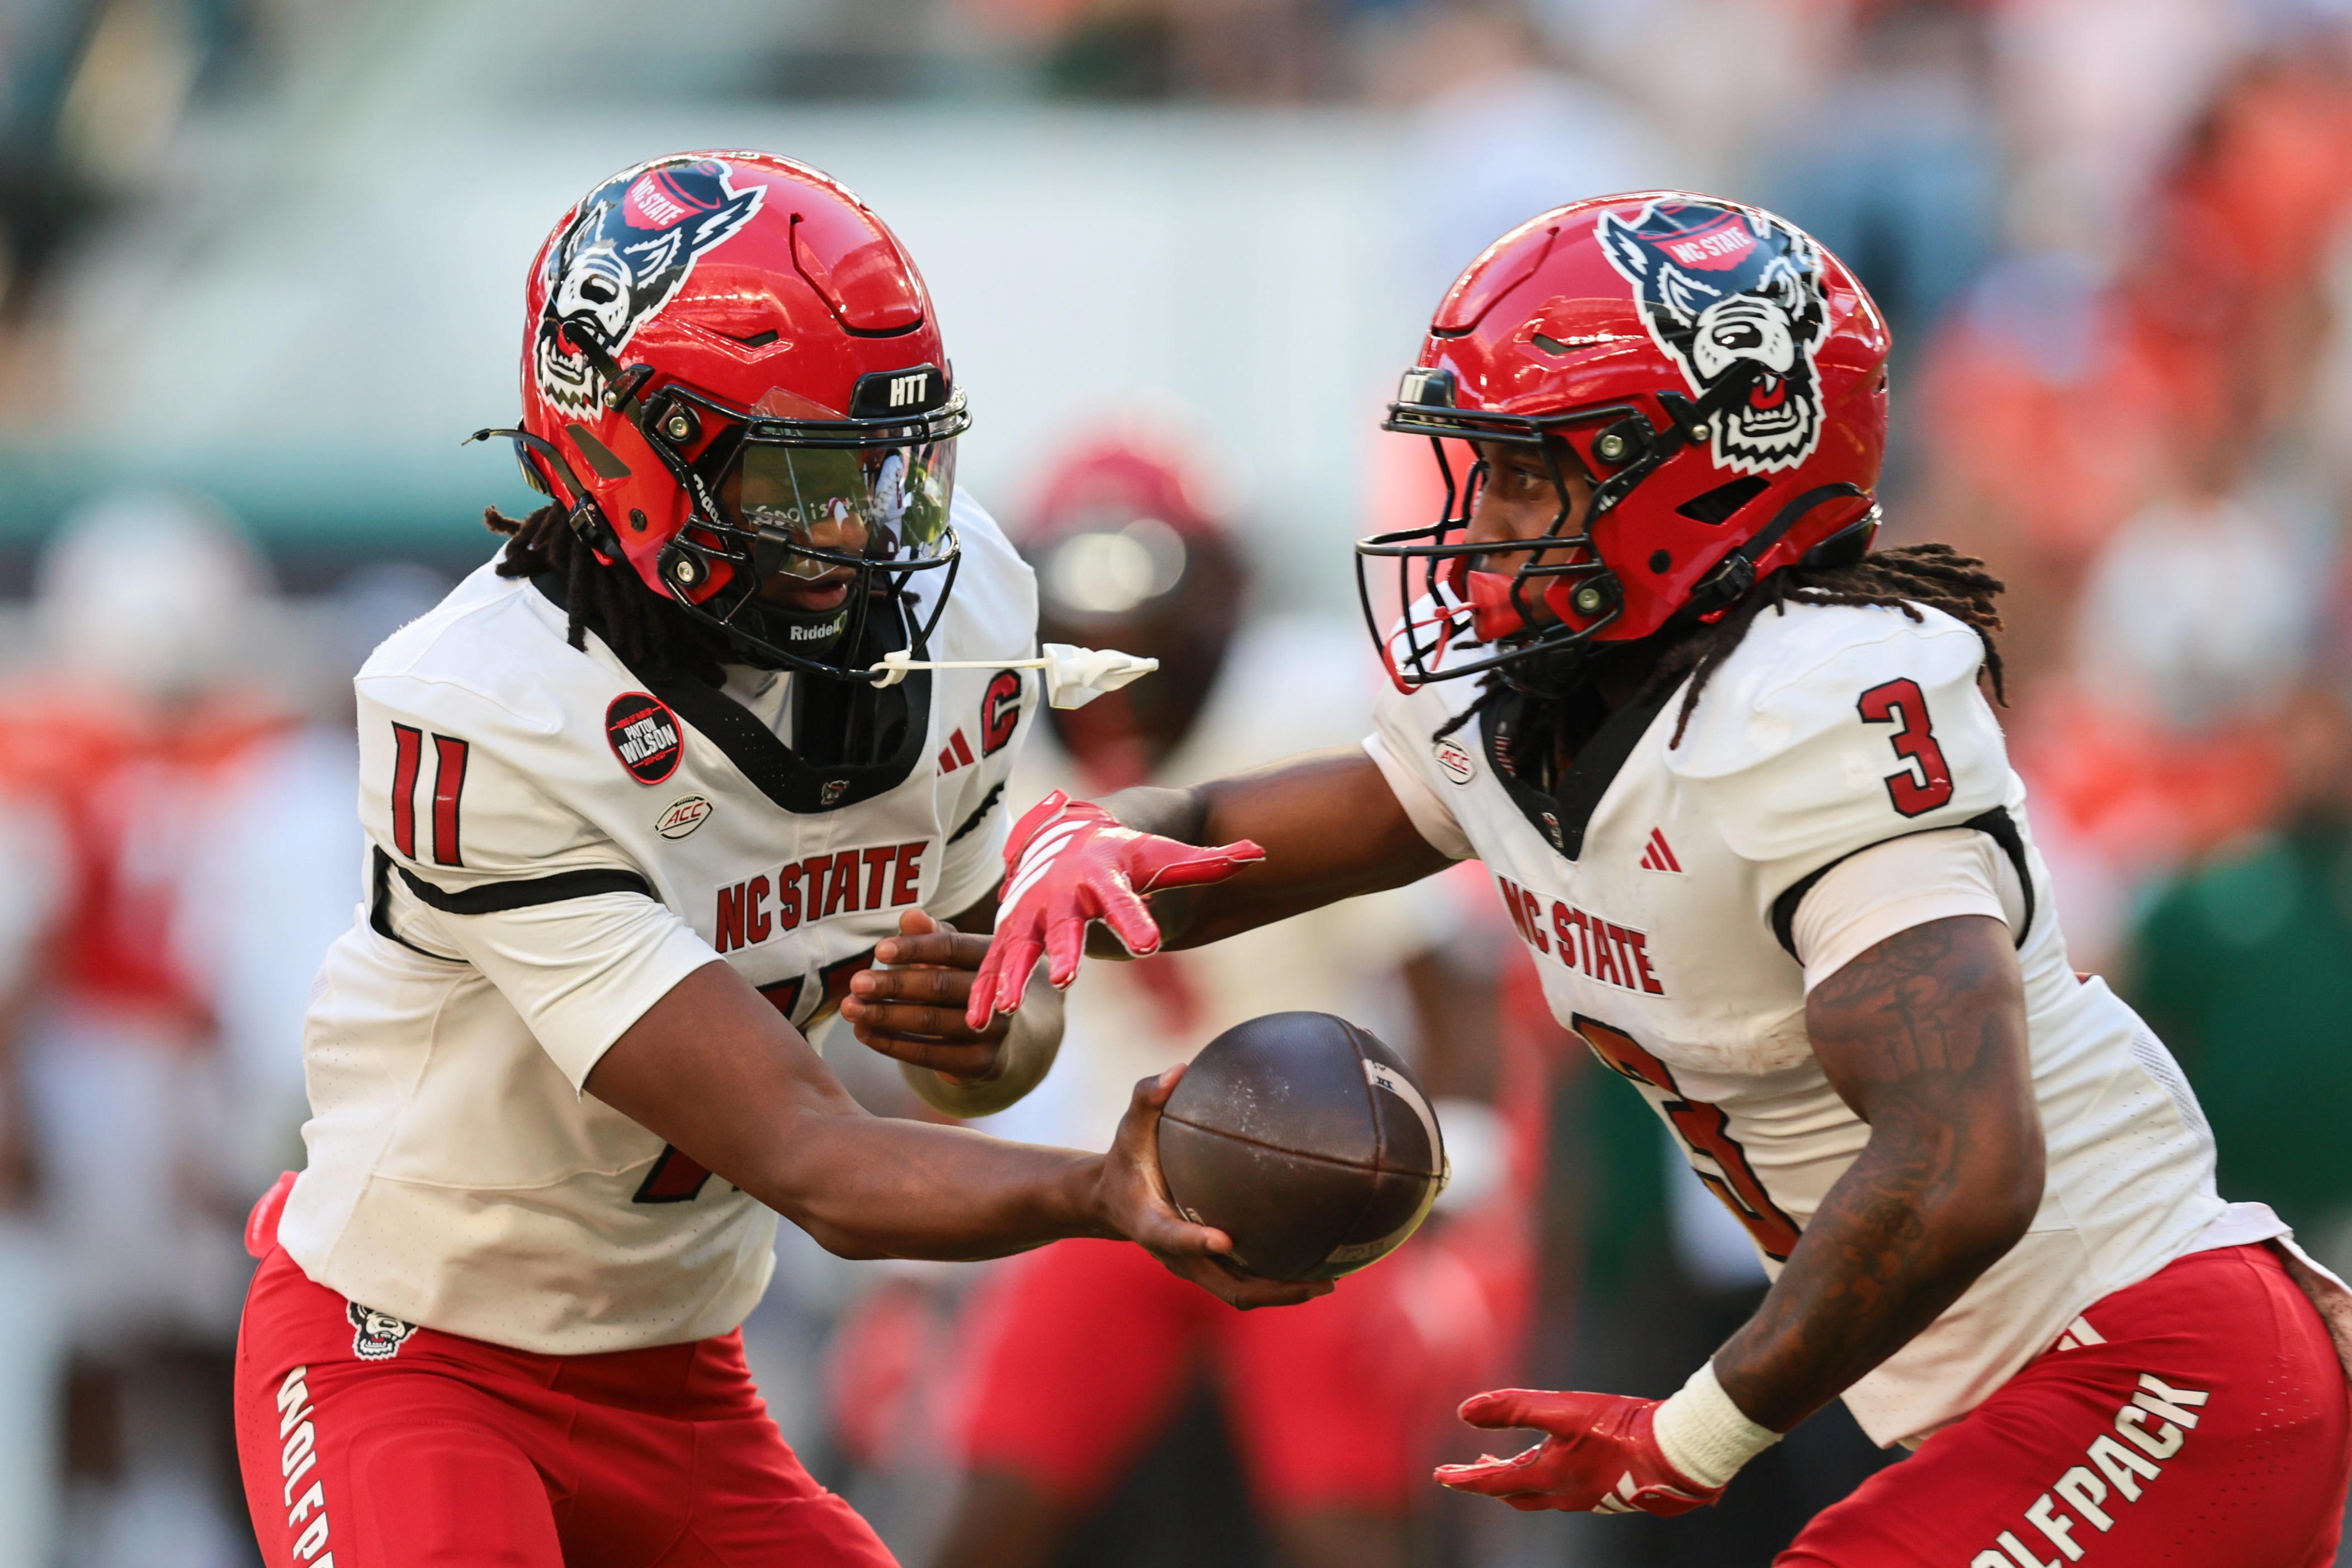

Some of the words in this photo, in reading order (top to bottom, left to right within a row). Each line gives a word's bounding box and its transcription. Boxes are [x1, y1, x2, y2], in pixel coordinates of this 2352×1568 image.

[631, 174, 655, 202] NC
[637, 192, 686, 226] STATE
[1669, 241, 1708, 263] NC
[1699, 226, 1751, 257] STATE
[890, 373, 928, 407] HTT
[790, 617, 840, 640] Riddell
[624, 716, 658, 740] PAYTON
[980, 669, 1022, 759] C
[618, 723, 678, 764] WILSON
[1441, 749, 1471, 772] ACC
[1855, 677, 1953, 818] 3
[391, 720, 469, 867] 11
[663, 801, 705, 828] ACC
[715, 874, 772, 953] NC
[779, 840, 930, 932] STATE
[1497, 870, 1550, 955] NC
[1552, 900, 1665, 996] STATE
